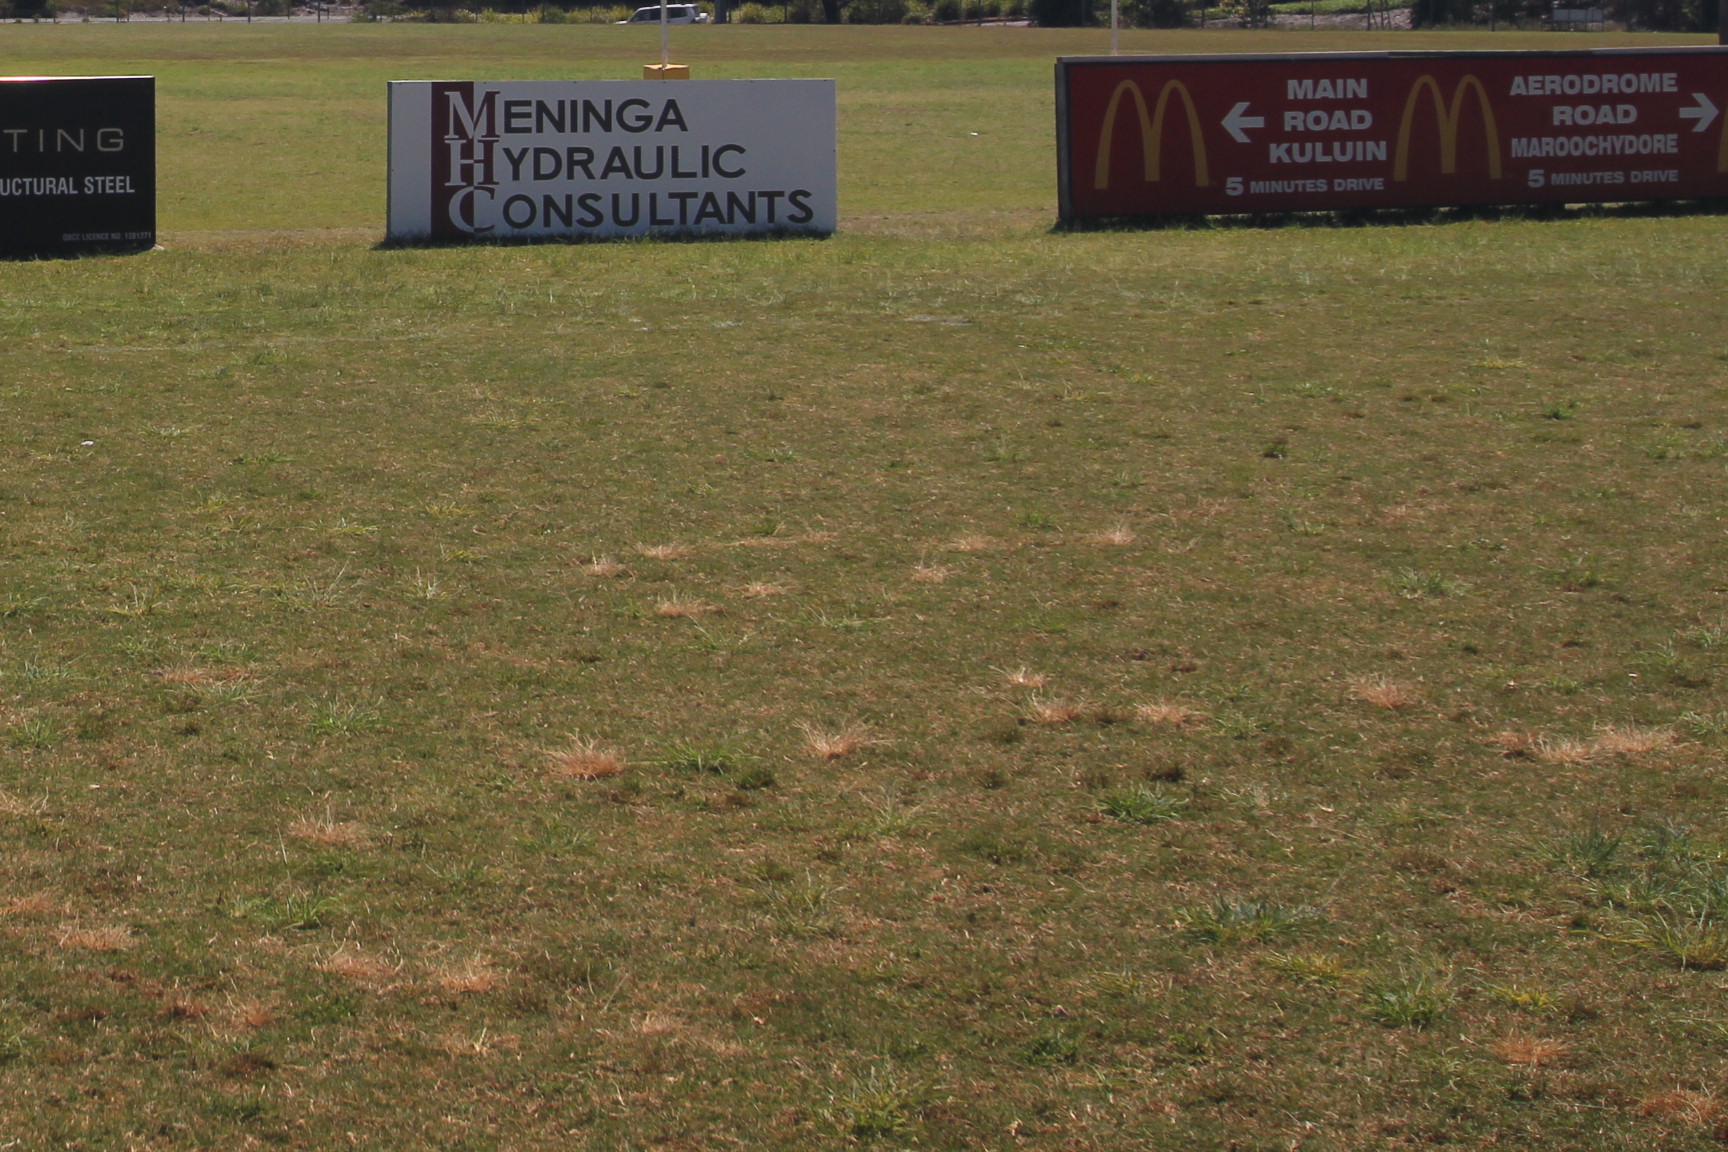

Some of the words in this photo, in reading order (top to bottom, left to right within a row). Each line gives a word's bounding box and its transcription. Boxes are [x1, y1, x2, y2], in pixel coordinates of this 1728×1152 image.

[1287, 78, 1368, 100] MAIN
[1509, 73, 1678, 95] AERODROME
[444, 90, 689, 140] MENINGA
[1283, 110, 1373, 131] ROAD
[1553, 104, 1638, 125] ROAD
[1269, 141, 1387, 164] KULUIN
[1511, 134, 1678, 158] MAROOCHYDORE
[444, 138, 747, 186] HYDRAULIC
[84, 175, 135, 195] STEEL
[1225, 177, 1244, 196] 5
[1249, 179, 1328, 194] MINUTES
[1334, 178, 1385, 192] DRIVE
[1528, 169, 1545, 187] 5
[1551, 171, 1625, 186] MINUTES
[1630, 169, 1679, 183] DRIVE
[448, 184, 814, 233] CONSULTANTS
